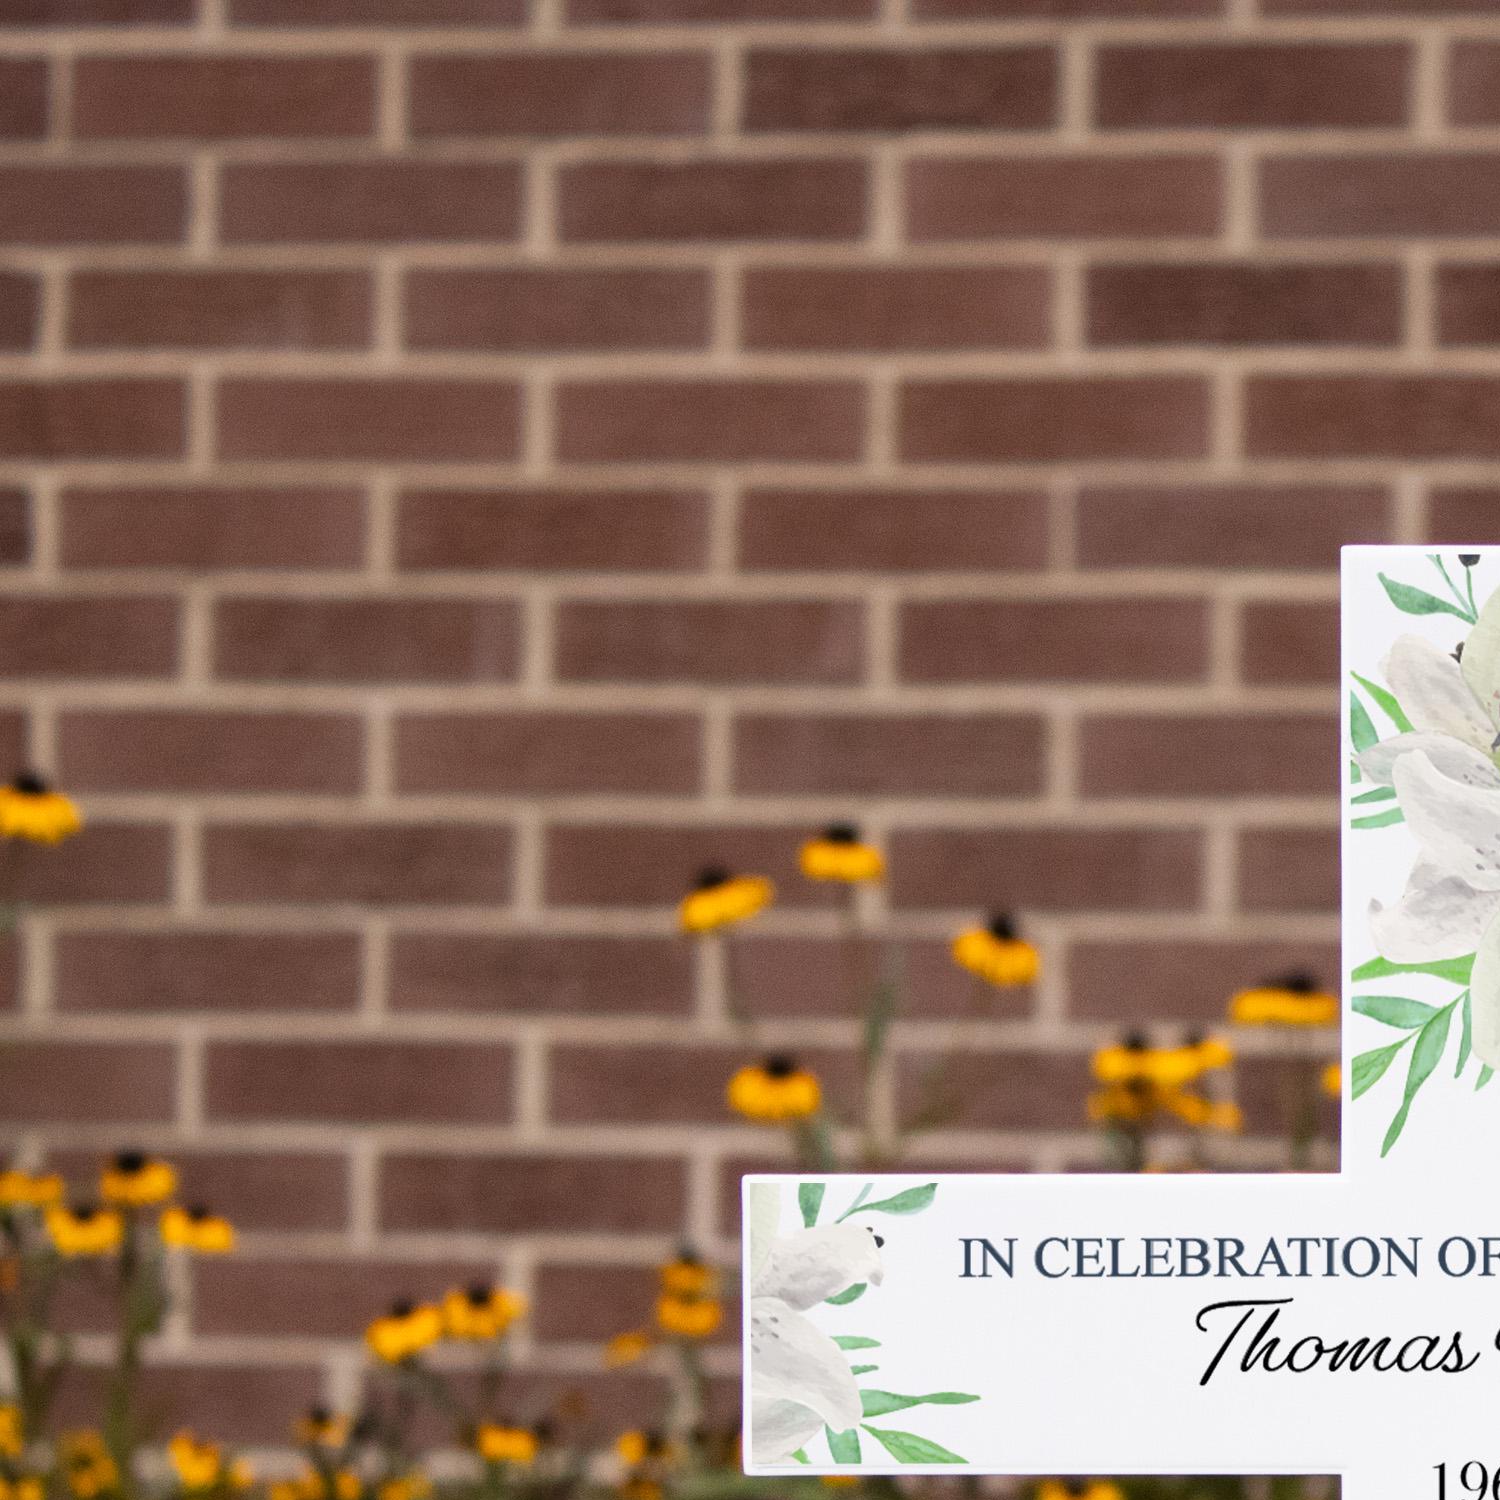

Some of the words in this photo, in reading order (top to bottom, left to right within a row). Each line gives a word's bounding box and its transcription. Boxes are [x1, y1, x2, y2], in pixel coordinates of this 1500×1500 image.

[959, 1237, 1019, 1279] IN
[1034, 1237, 1423, 1279] CELEBRATION
[1195, 1298, 1480, 1387] Thomas
